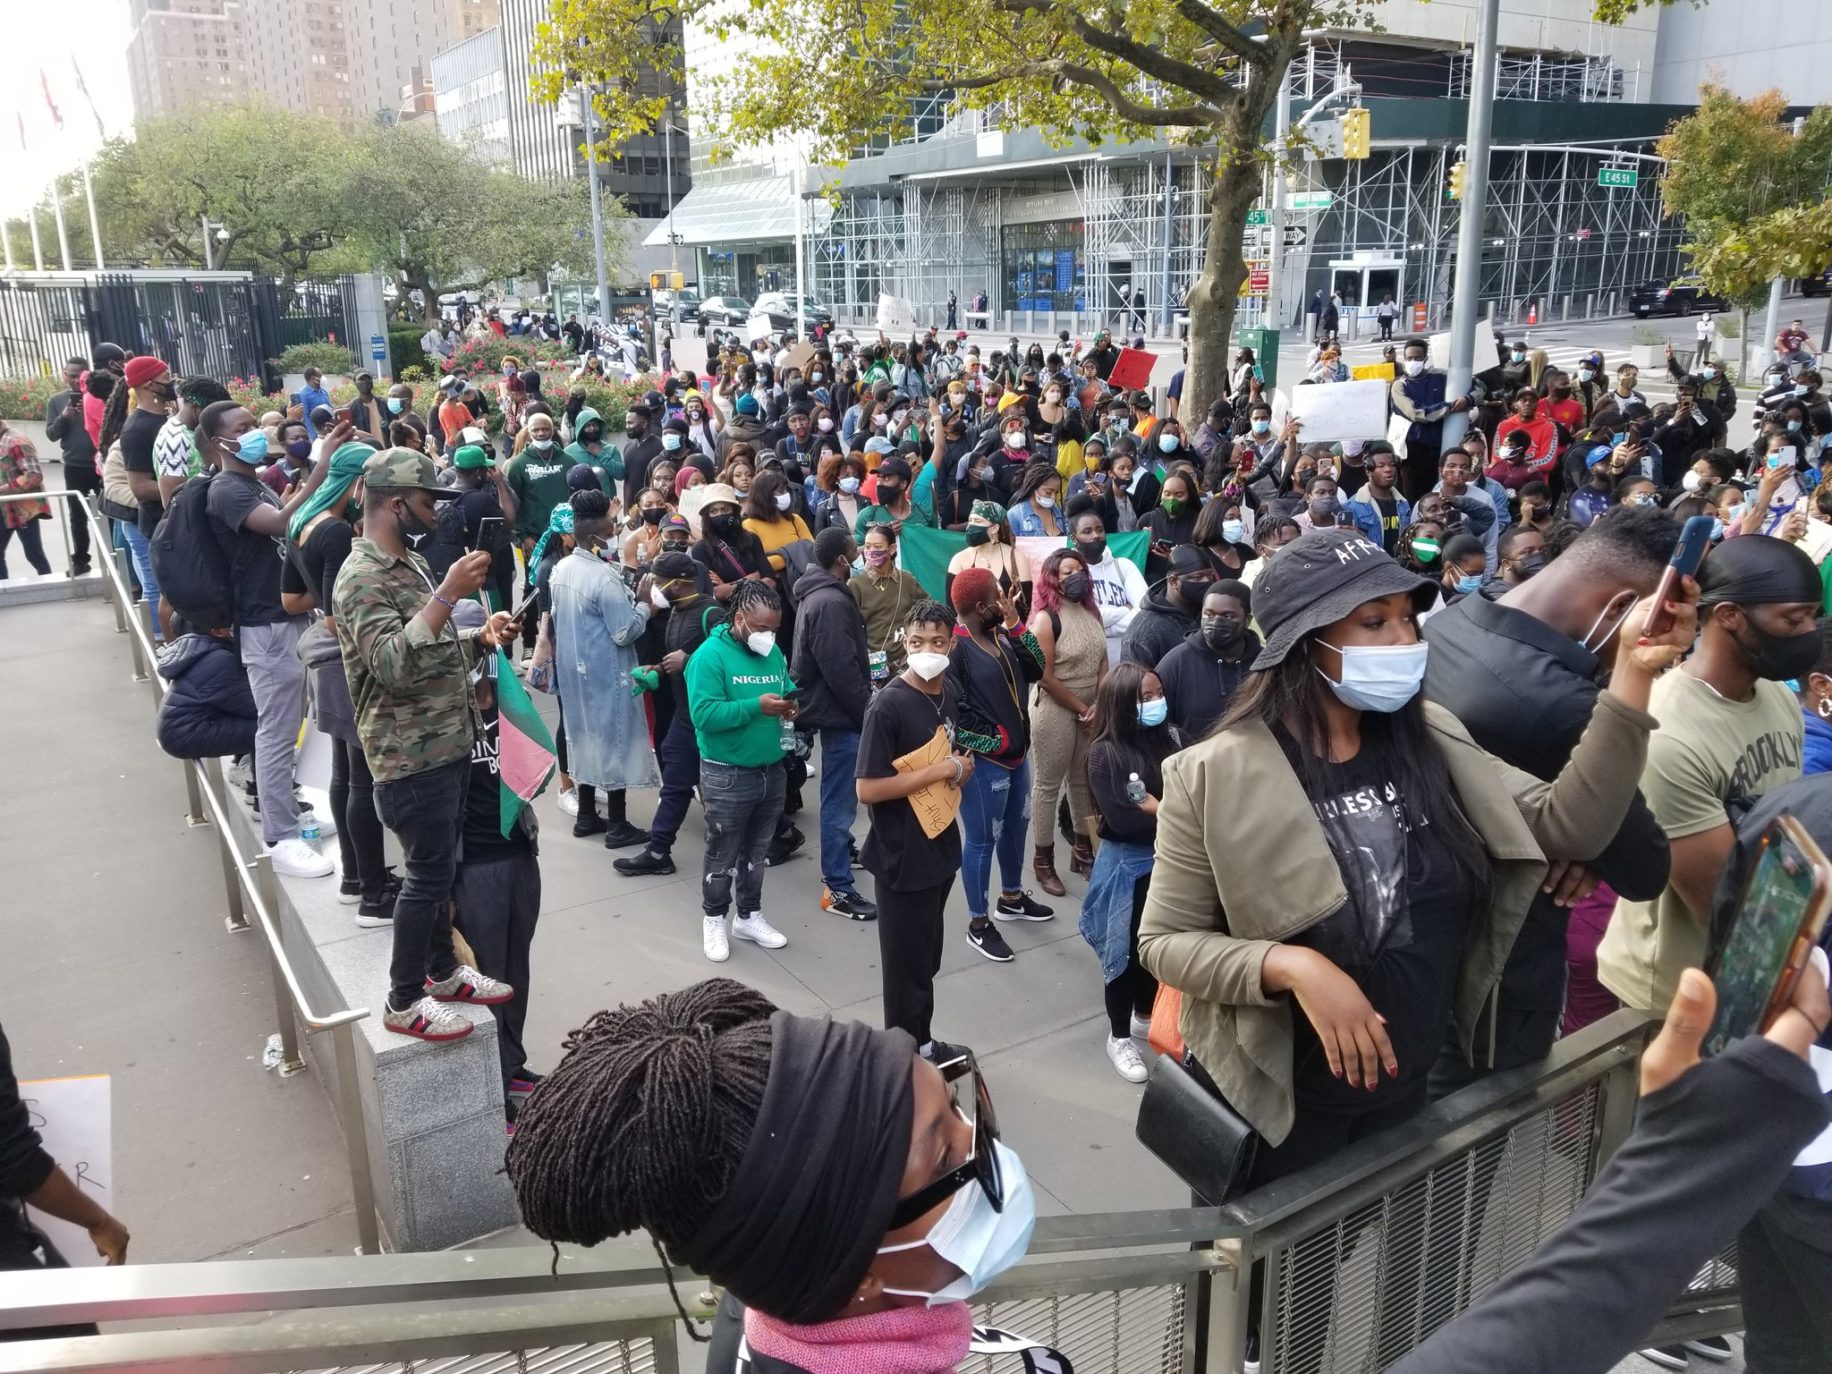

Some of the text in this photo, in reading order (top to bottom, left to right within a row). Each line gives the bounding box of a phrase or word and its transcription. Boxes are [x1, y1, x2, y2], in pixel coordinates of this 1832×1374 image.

[1605, 172, 1630, 184] E 45 St
[1247, 211, 1260, 223] 45
[1285, 231, 1301, 240] WAY
[732, 674, 781, 685] NIGERIA
